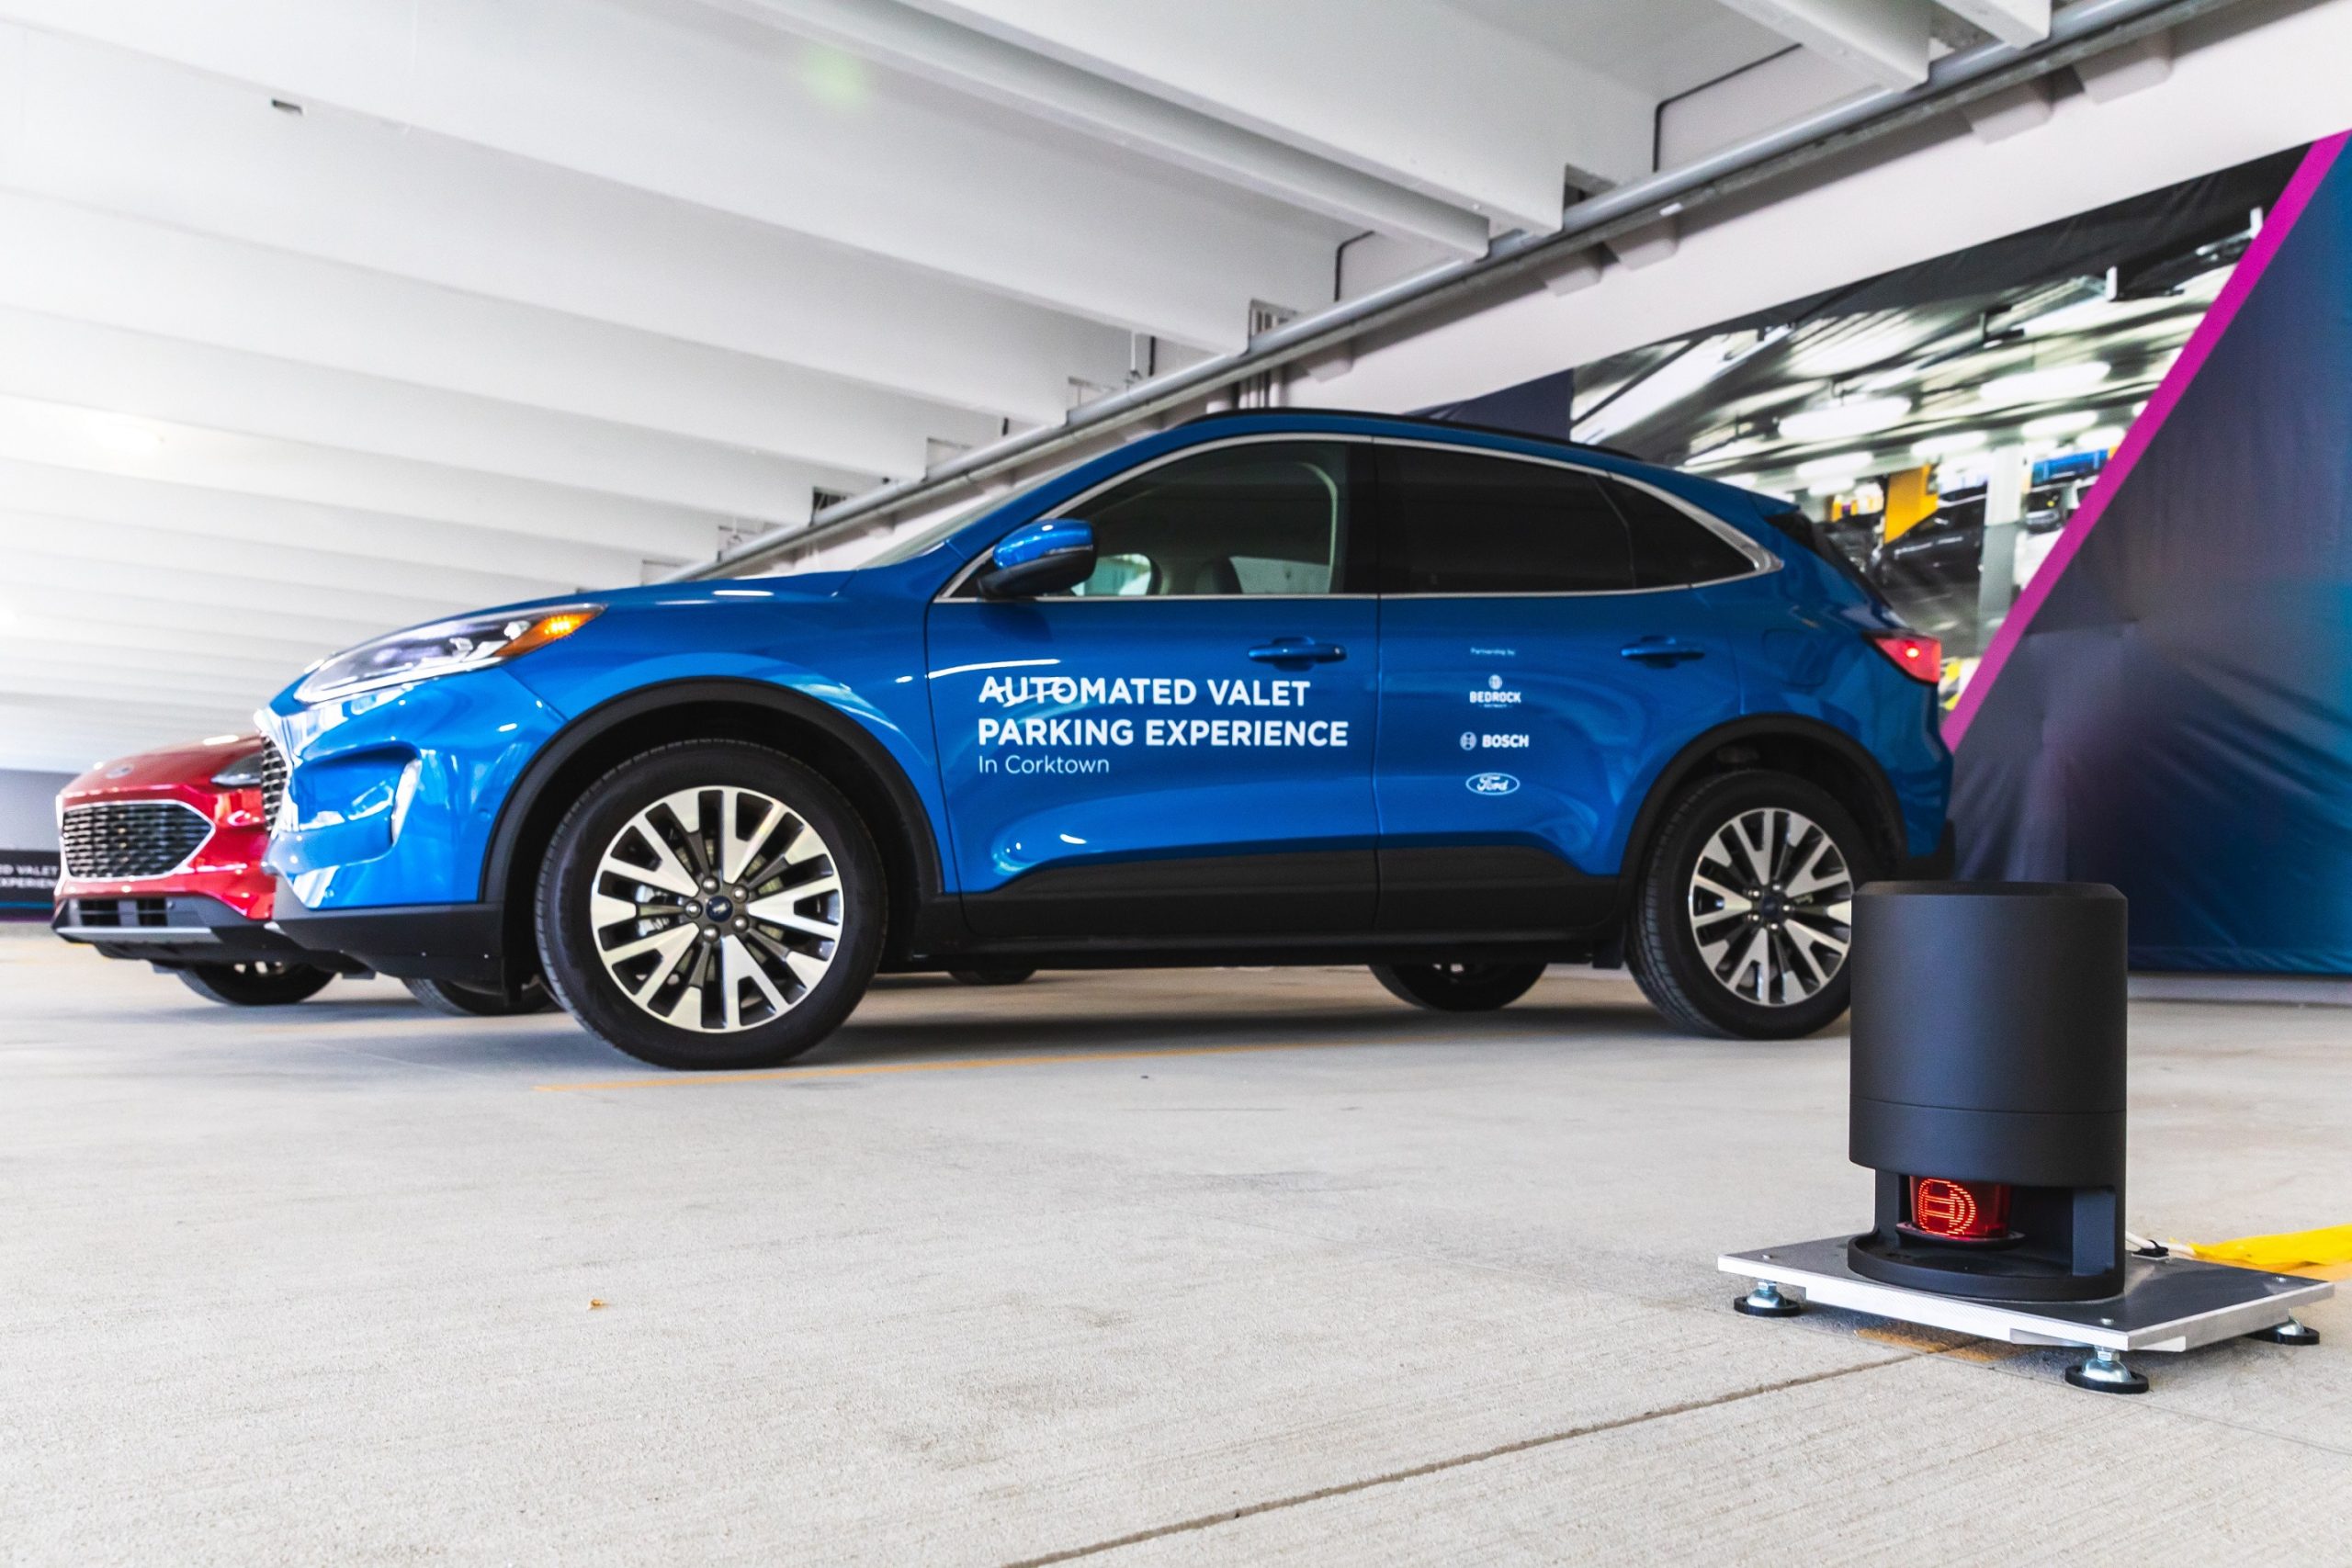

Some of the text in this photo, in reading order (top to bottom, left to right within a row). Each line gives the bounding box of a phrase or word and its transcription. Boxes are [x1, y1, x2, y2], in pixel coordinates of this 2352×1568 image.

[978, 676, 1310, 706] AUTOMATED VALET
[1469, 691, 1521, 704] BEDROCK
[978, 718, 1349, 747] PARKING EXPERIENCE
[1482, 734, 1530, 748] BOSCH
[978, 755, 1110, 773] In Corktown
[1475, 773, 1510, 793] Ford
[16, 864, 59, 876] VALET
